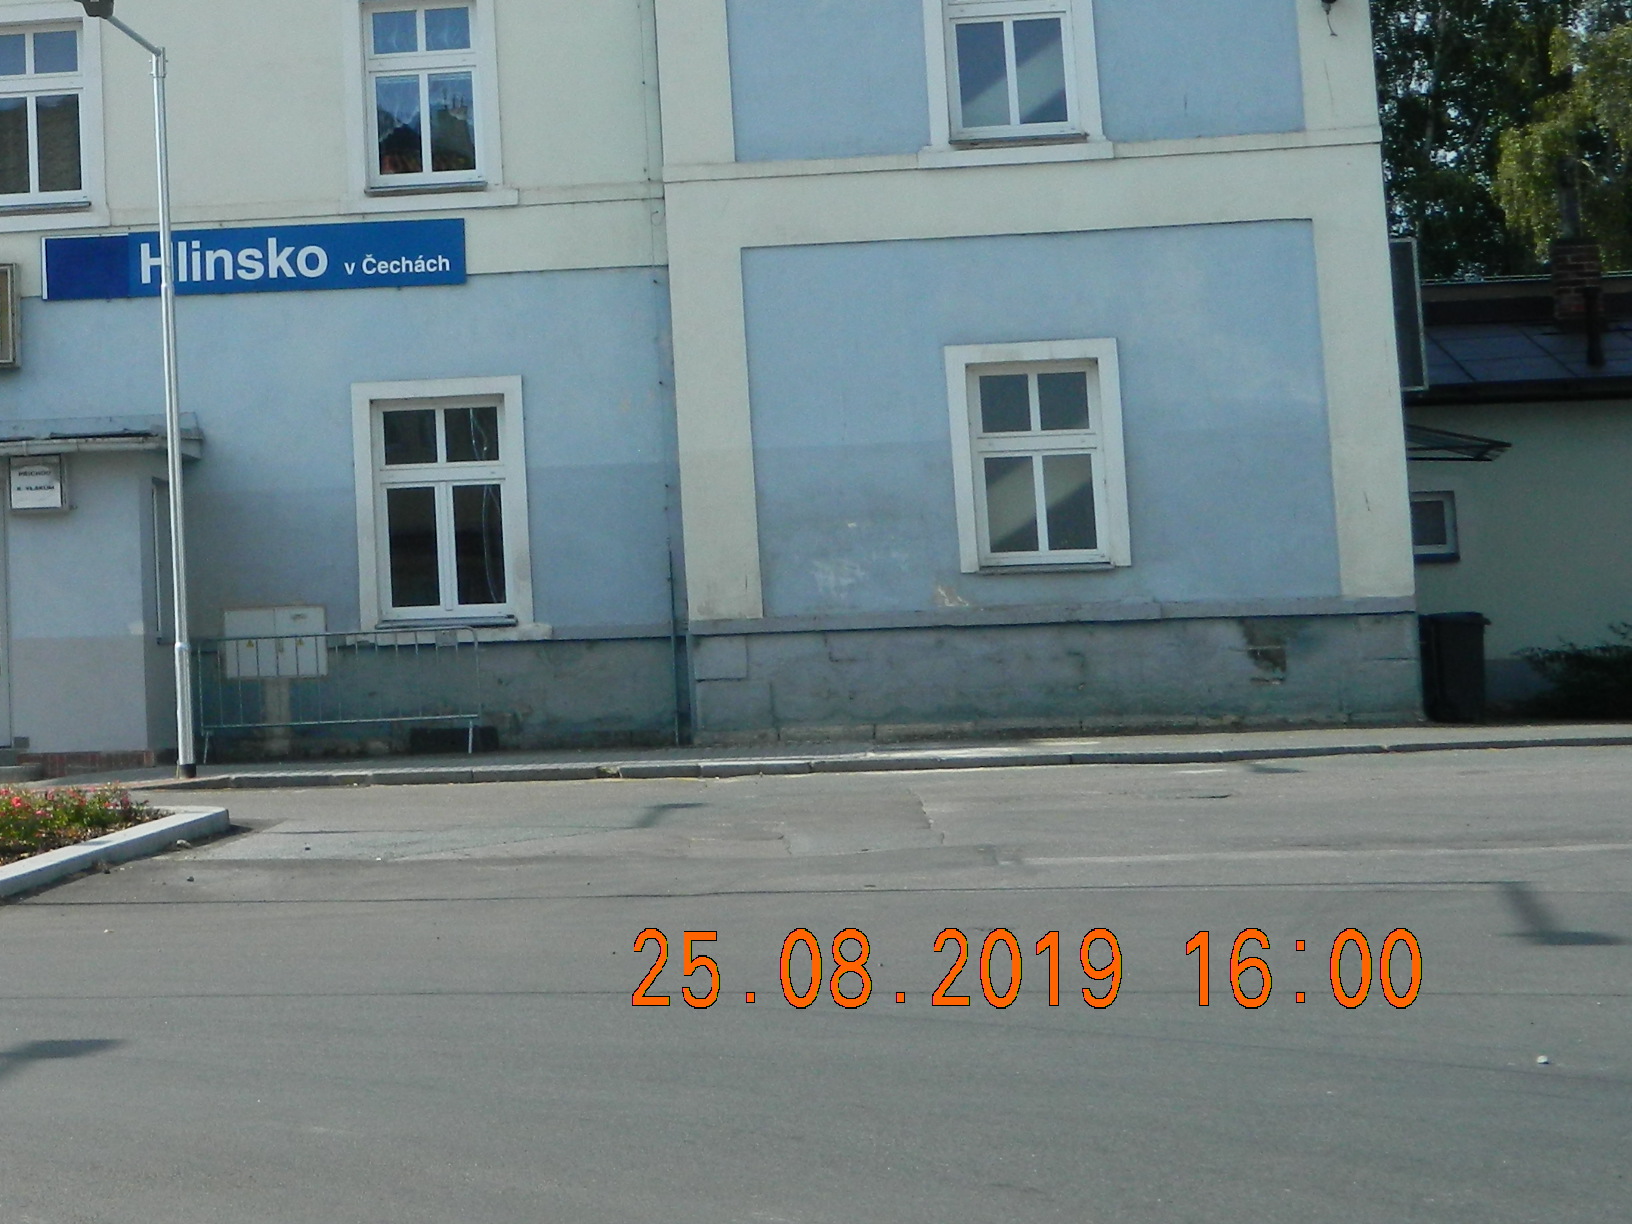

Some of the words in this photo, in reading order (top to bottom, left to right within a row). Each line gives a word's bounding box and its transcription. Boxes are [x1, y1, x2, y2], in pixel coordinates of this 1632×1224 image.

[140, 236, 329, 285] Hlinsko
[344, 261, 356, 276] v
[361, 253, 451, 276] Čechách
